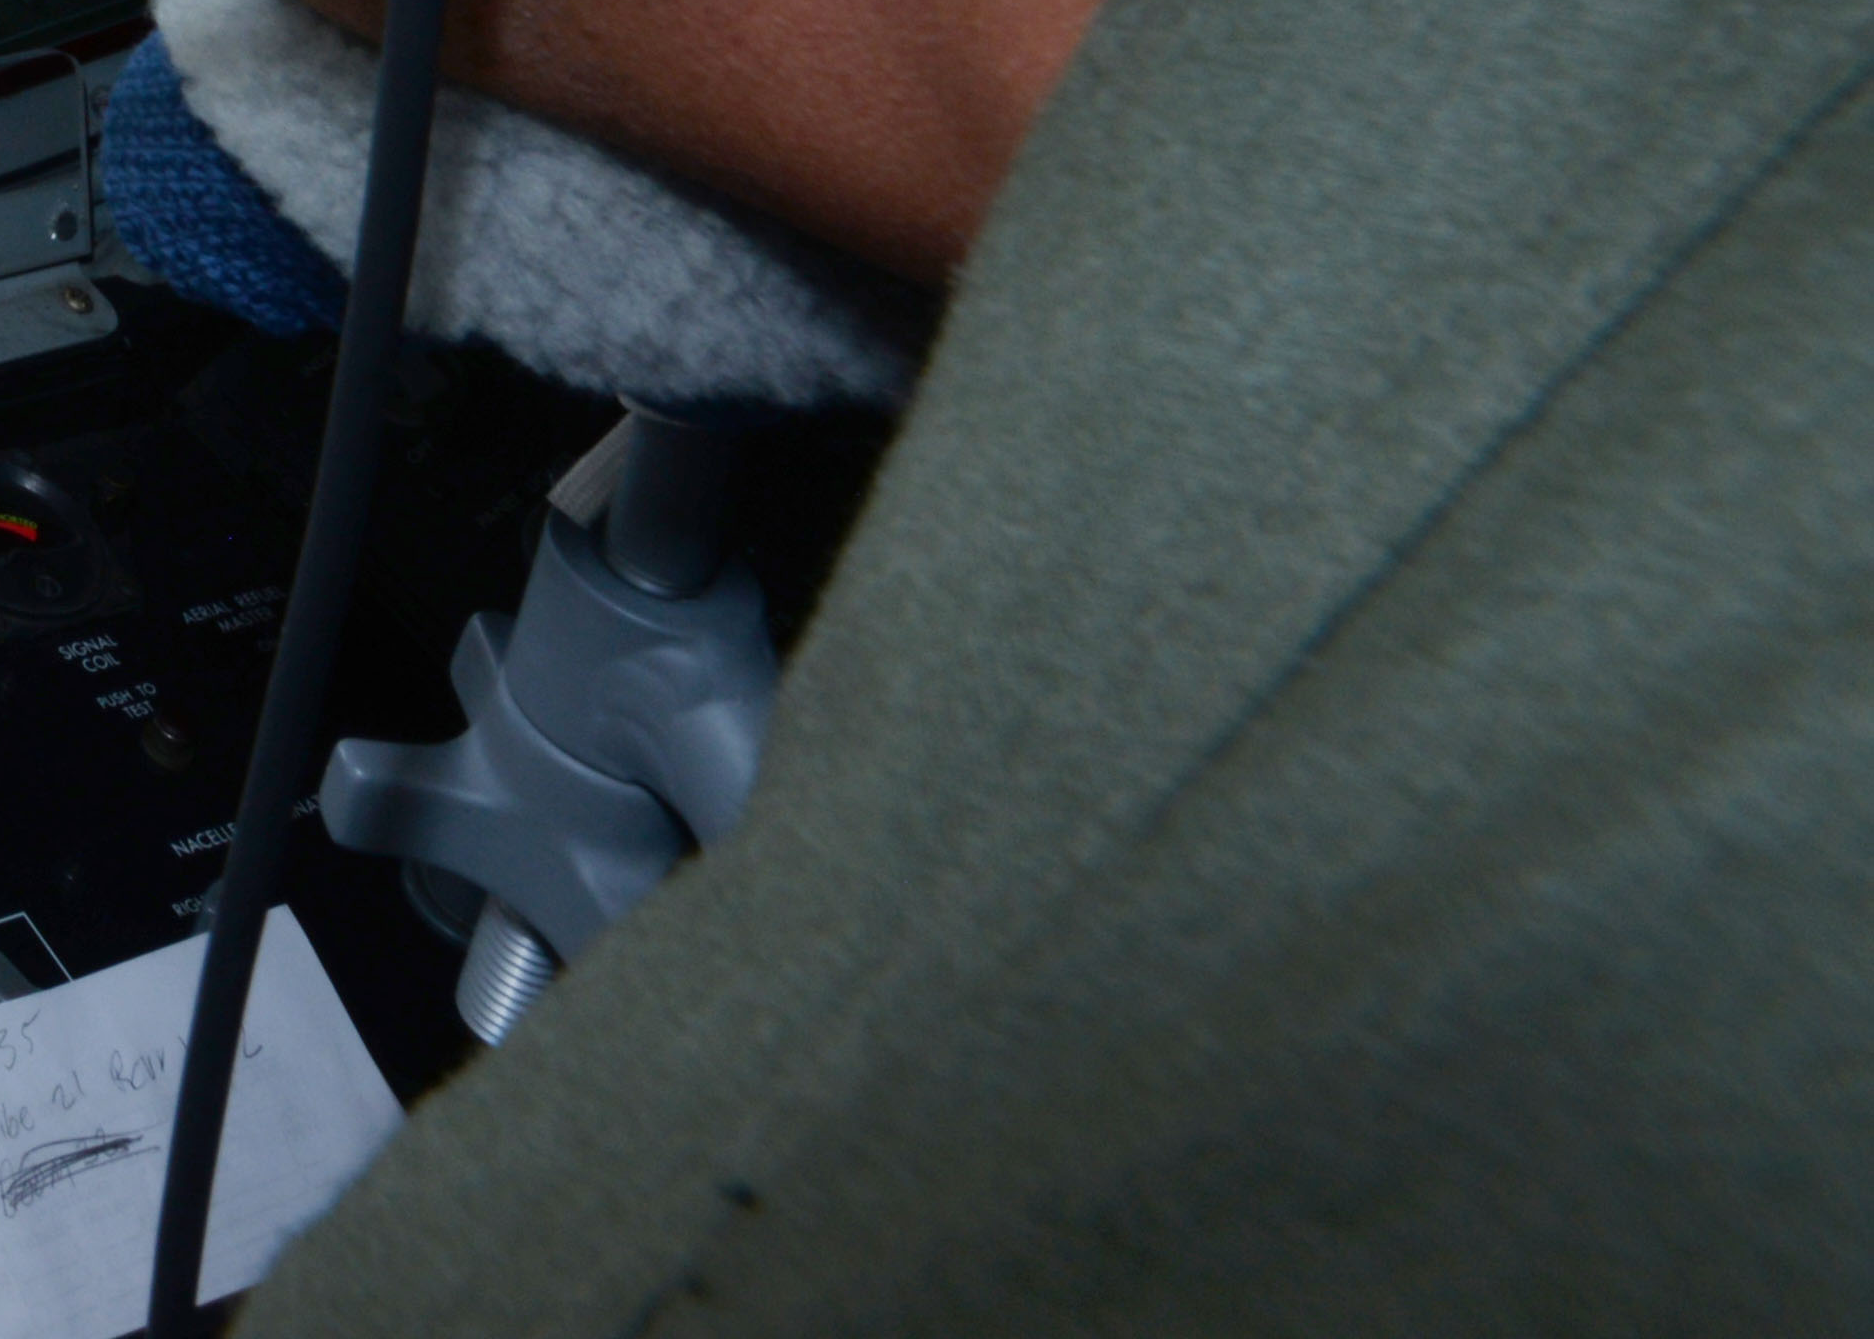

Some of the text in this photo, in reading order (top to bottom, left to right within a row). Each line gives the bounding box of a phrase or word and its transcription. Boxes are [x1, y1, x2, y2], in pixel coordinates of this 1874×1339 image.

[58, 633, 119, 663] SIGNAL
[82, 654, 122, 675] COIL
[95, 681, 157, 710] PUSH TO
[121, 702, 154, 721] TEST
